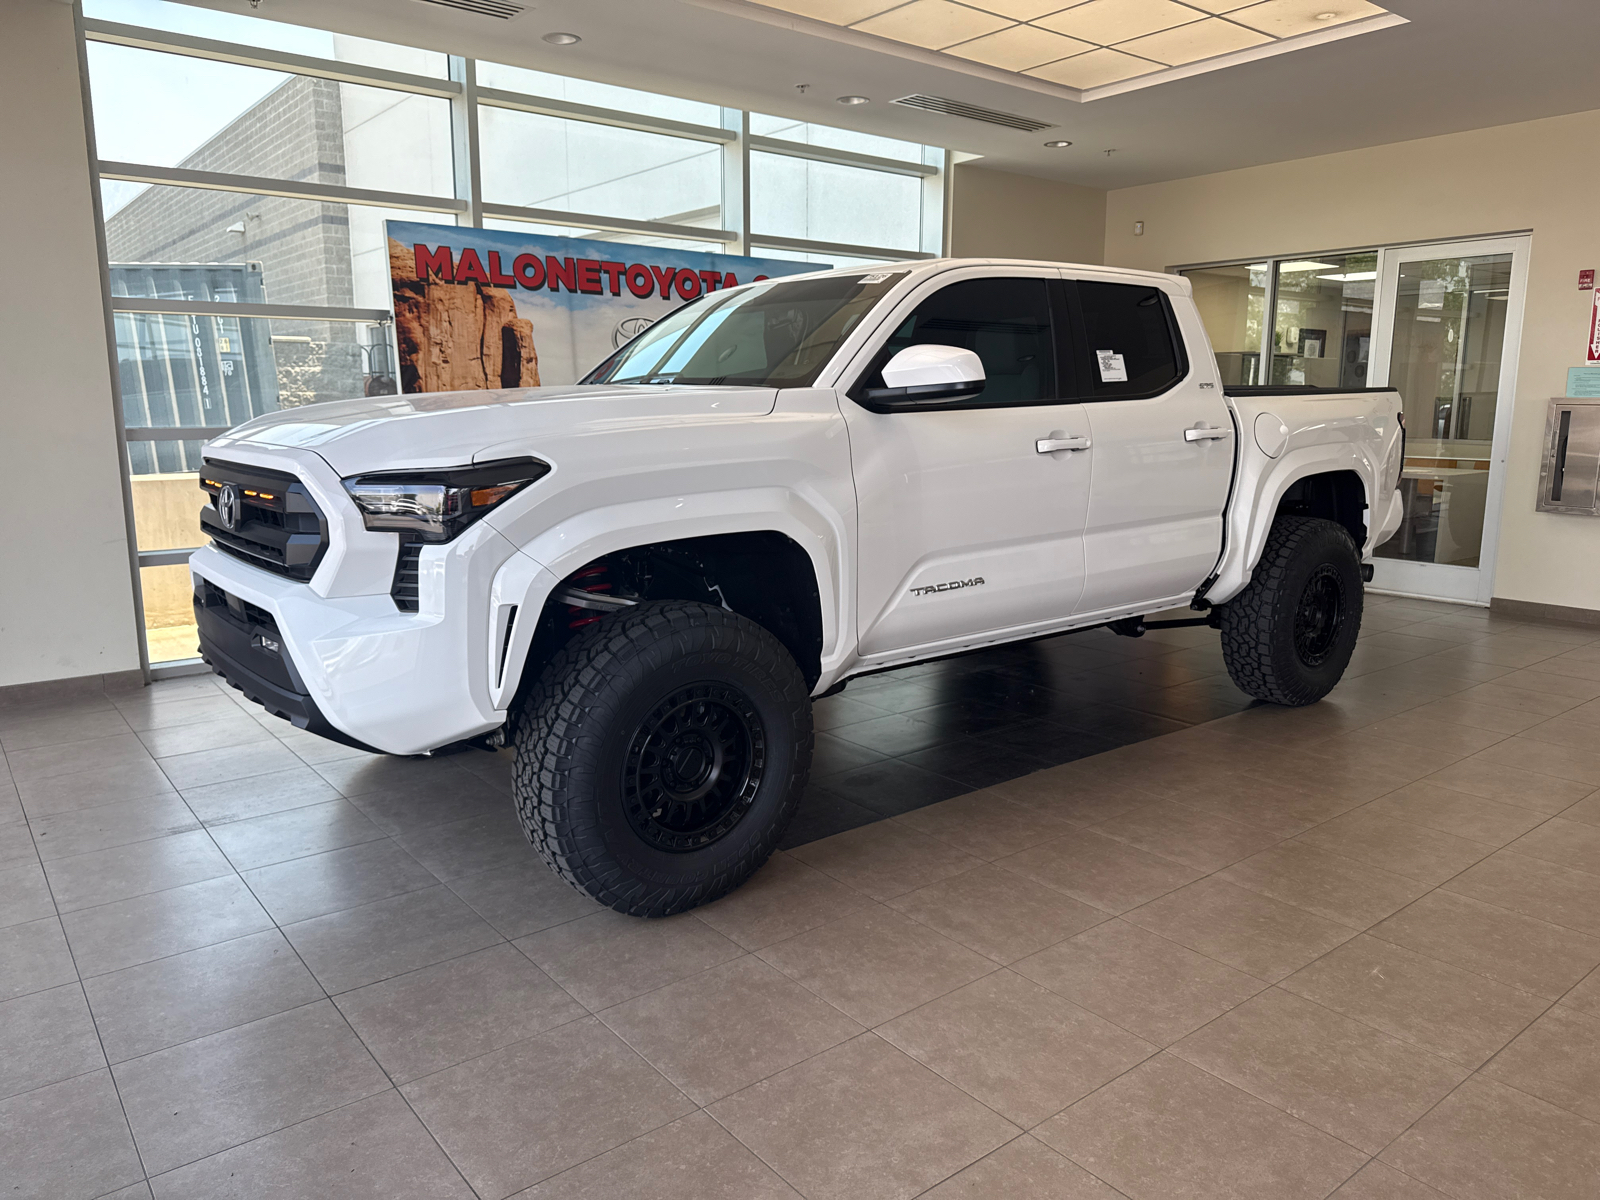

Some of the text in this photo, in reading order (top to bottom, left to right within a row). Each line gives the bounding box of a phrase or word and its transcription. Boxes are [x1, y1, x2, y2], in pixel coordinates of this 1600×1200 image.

[413, 243, 770, 301] MALONETOYOTA
[909, 577, 985, 597] TACOMA
[671, 652, 785, 703] TOYO TIRES
[713, 829, 761, 875] OPEN
